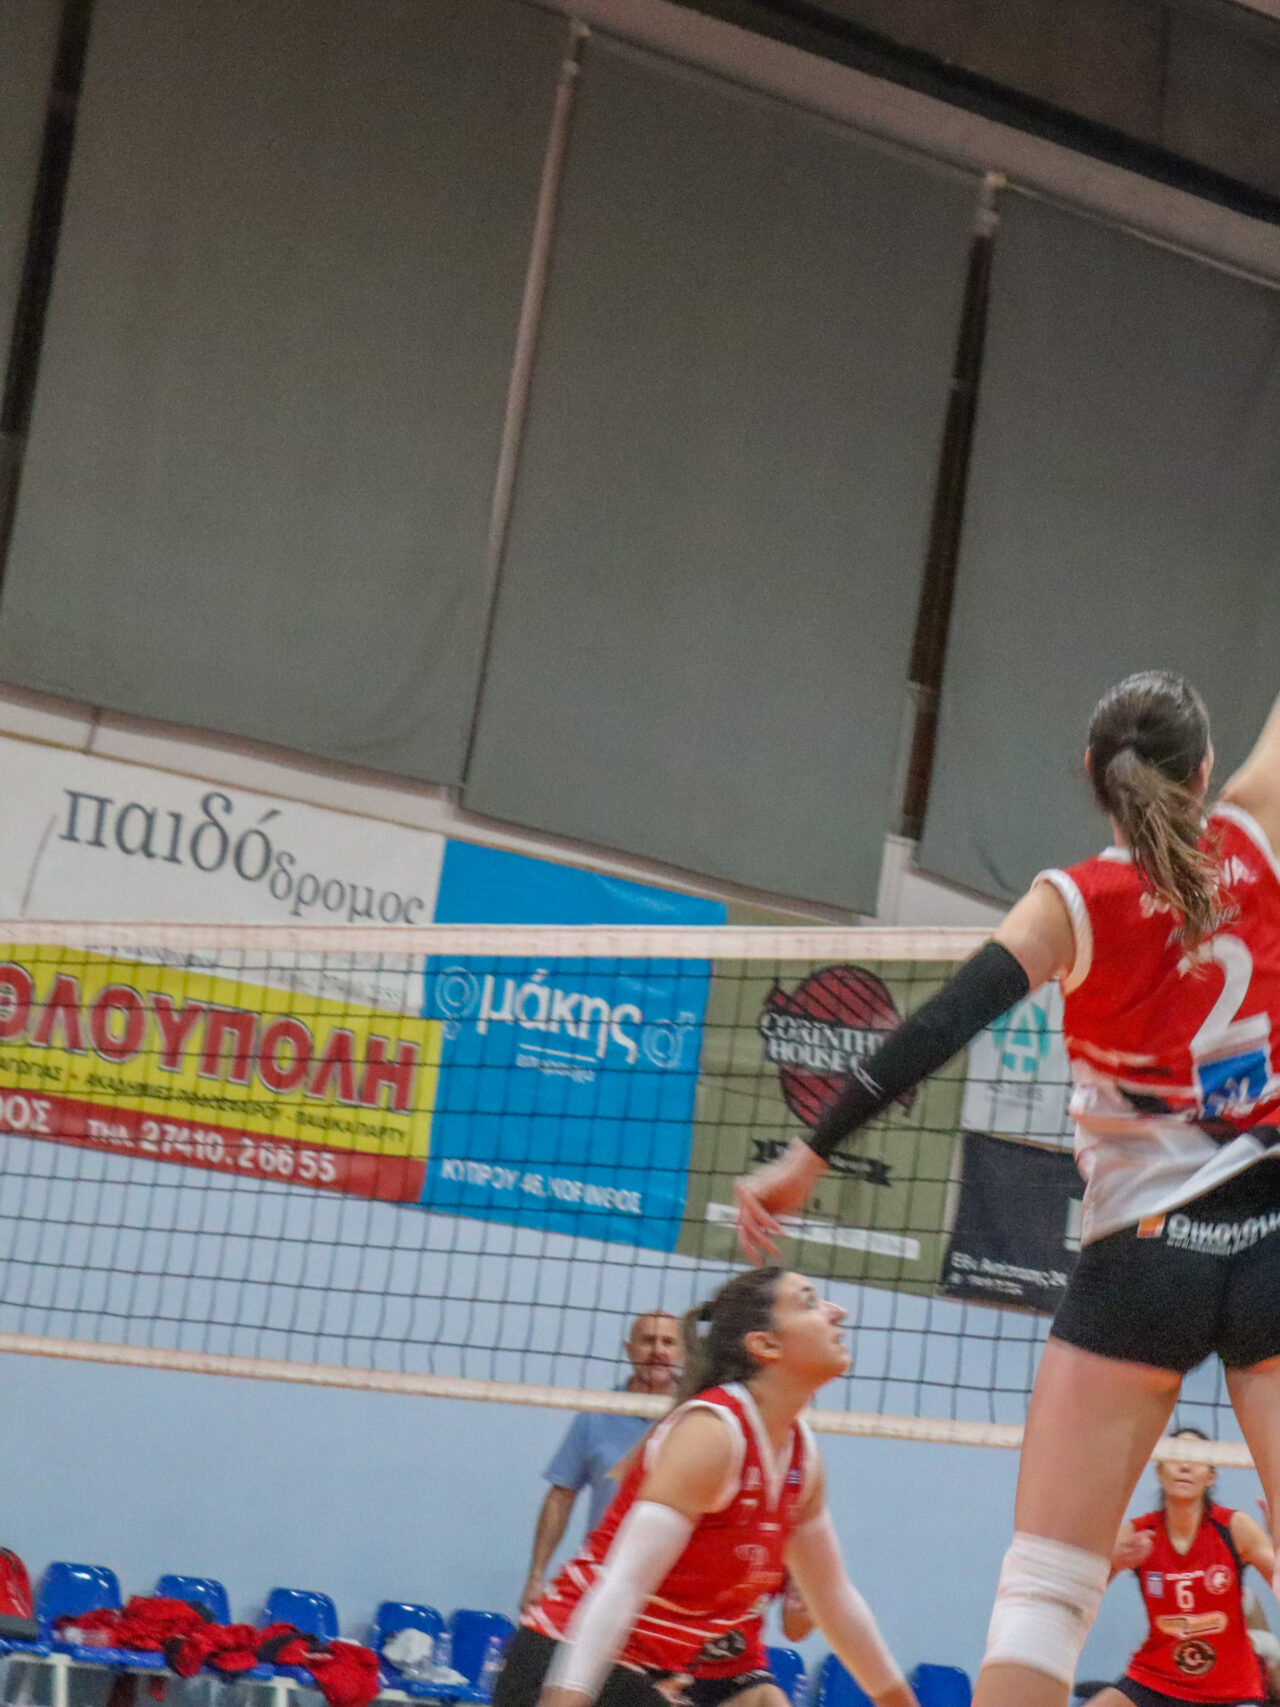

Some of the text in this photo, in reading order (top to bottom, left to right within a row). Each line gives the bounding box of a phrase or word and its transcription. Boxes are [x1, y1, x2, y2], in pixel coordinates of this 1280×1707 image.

[475, 967, 644, 1065] μάκης
[1177, 932, 1271, 1060] 2
[0, 1094, 52, 1133] ΟΣ
[1175, 1580, 1195, 1609] 6
